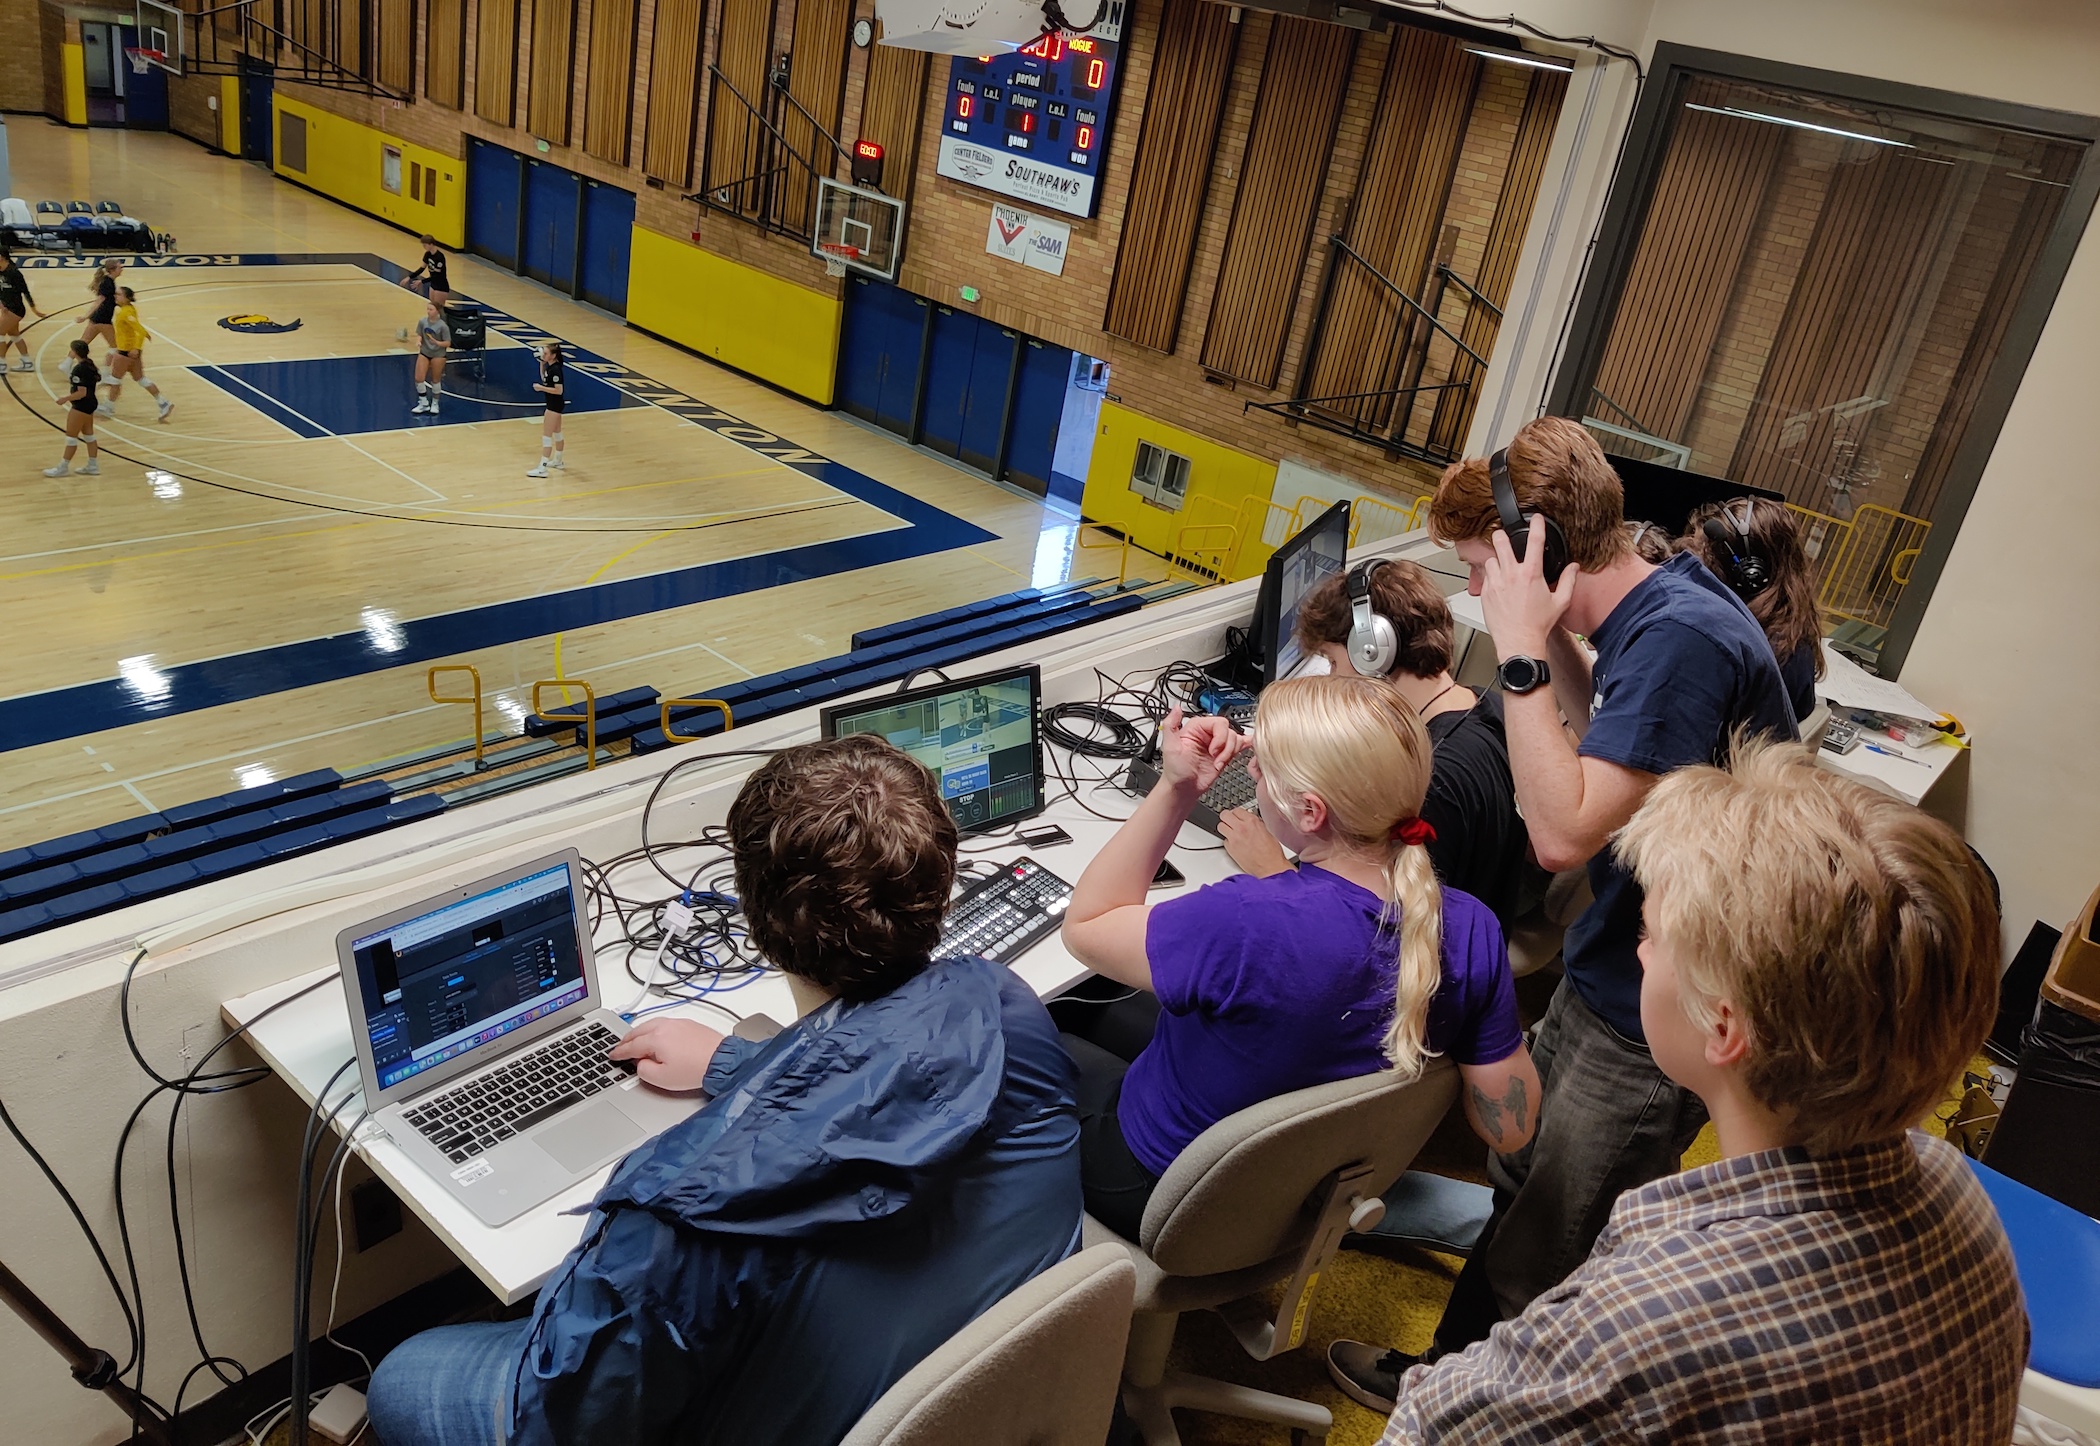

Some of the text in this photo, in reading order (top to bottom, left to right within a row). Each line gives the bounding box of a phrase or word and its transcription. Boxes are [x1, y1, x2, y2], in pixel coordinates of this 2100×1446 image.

[1015, 71, 1041, 88] period
[1087, 59, 1104, 89] 0
[957, 79, 975, 94] fouls
[959, 96, 970, 117] 0
[1011, 93, 1038, 109] player
[1023, 114, 1029, 132] 1
[1076, 109, 1096, 125] fouls
[952, 120, 968, 133] won
[1007, 134, 1028, 149] game
[1078, 127, 1090, 149] 0
[954, 147, 972, 159] CENTER
[1071, 151, 1088, 164] won
[1005, 159, 1081, 196] SOUTHPAW'S
[995, 206, 1029, 226] PHOENIX
[1006, 220, 1015, 230] INN
[1037, 235, 1062, 255] SAM
[10, 255, 240, 268] ROADRU
[959, 794, 975, 803] STOP
